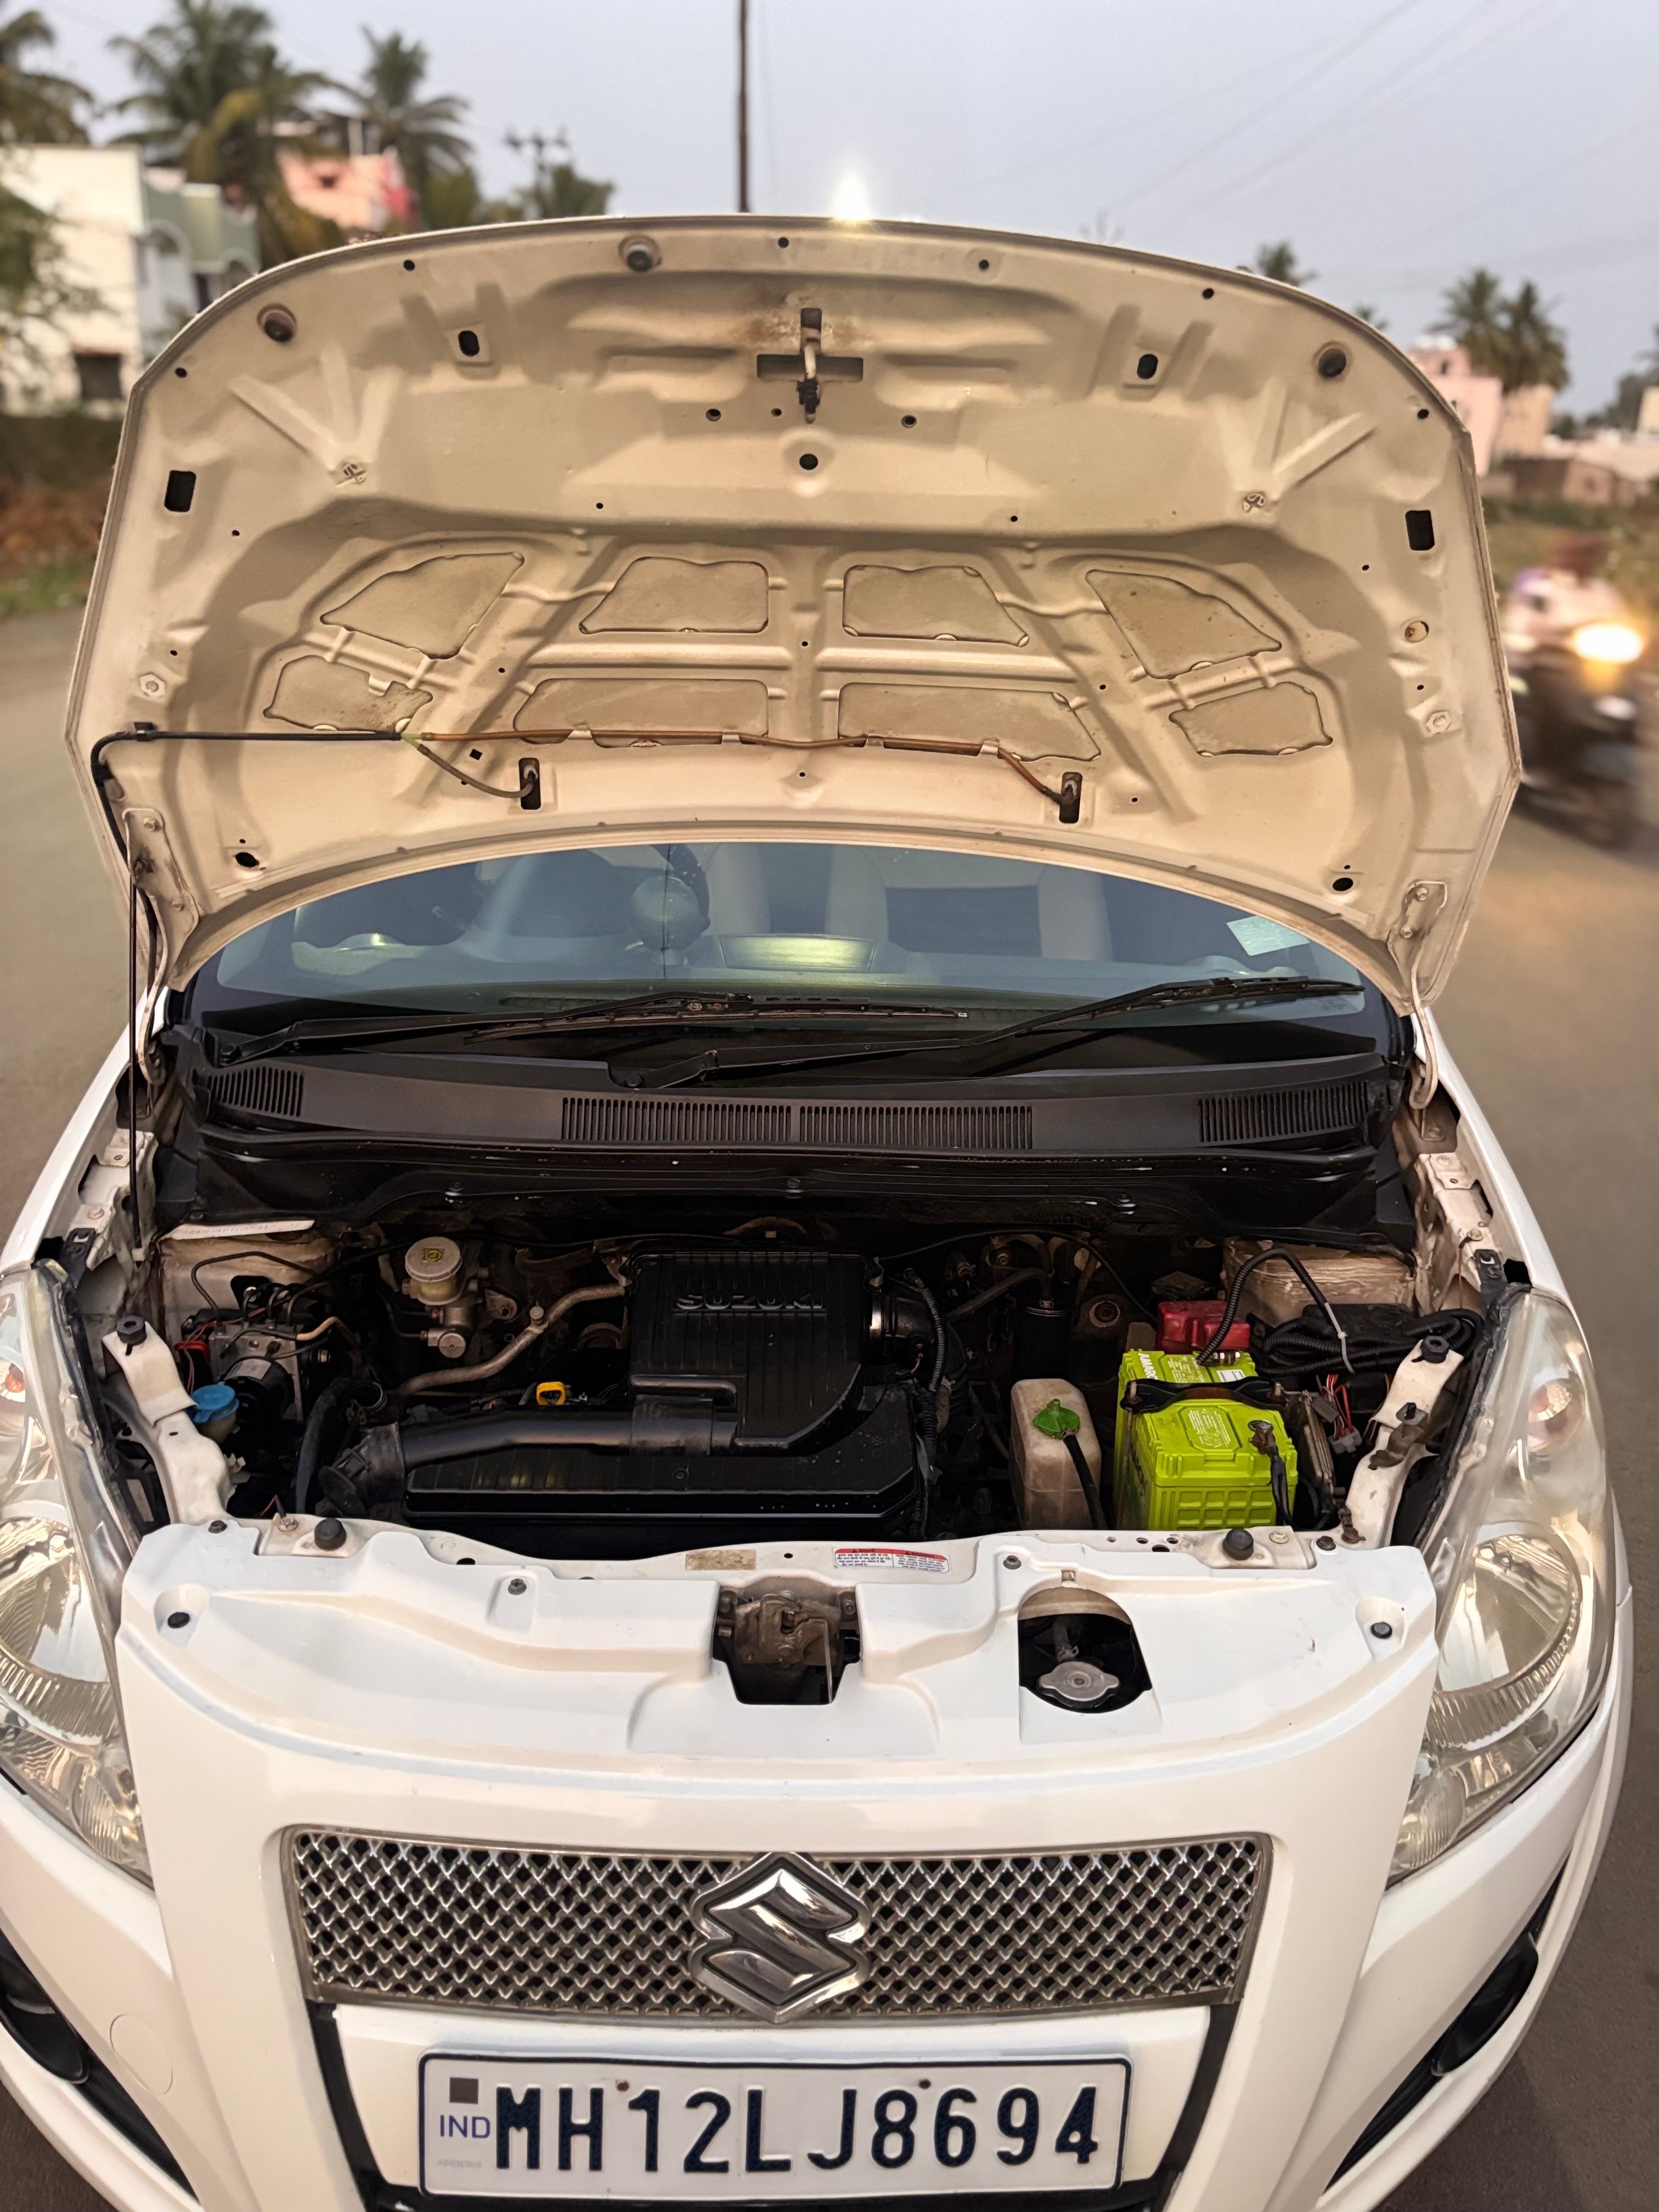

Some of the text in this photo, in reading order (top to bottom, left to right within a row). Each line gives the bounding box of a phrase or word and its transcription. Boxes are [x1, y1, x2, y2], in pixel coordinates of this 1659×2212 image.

[676, 1293, 823, 1311] SUZUKI
[440, 2115, 490, 2138] IND
[496, 2086, 1099, 2174] MH12LJ8694
